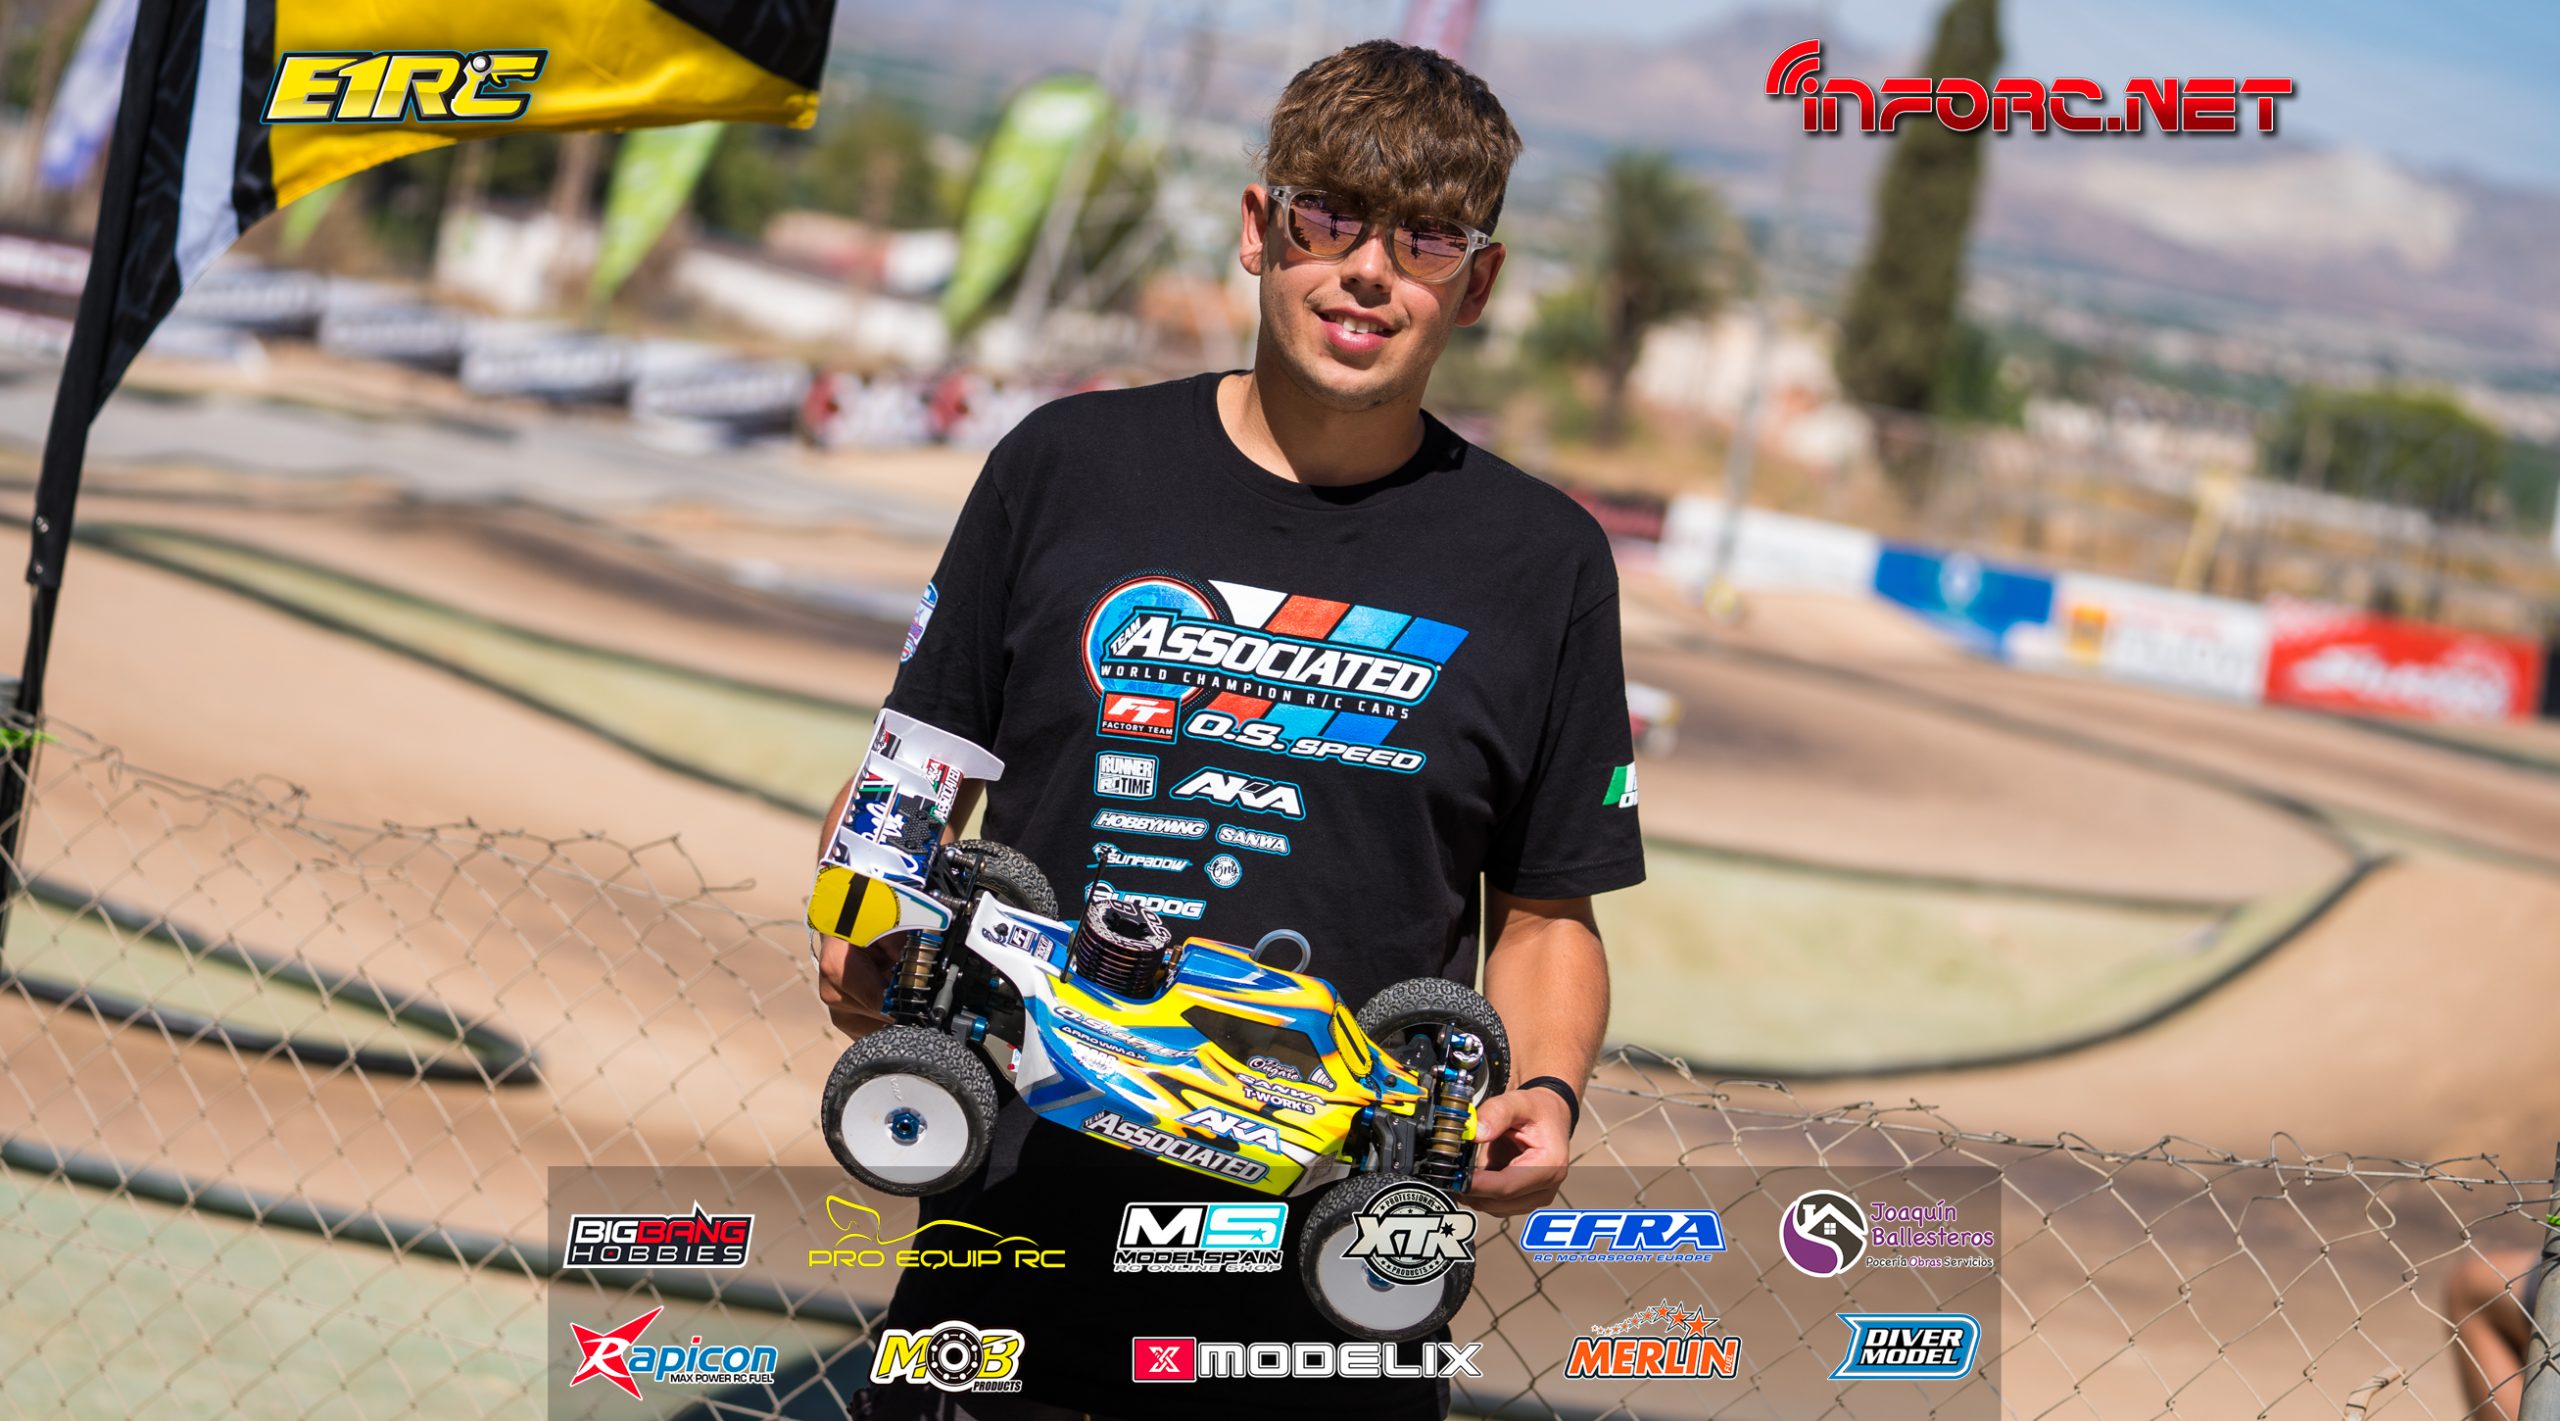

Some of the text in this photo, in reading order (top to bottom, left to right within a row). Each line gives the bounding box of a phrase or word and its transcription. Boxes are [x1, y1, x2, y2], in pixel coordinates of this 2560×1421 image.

[1109, 616, 1433, 700] TEAM ASSOCIATED
[1100, 664, 1410, 720] WORLD CHAMPION R/C CARS
[1107, 697, 1170, 723] FT
[1102, 720, 1174, 736] FACTORY TEAM
[1186, 712, 1423, 770] O.S. SPEED
[1099, 755, 1154, 778] RUNNER
[1121, 776, 1152, 795] TIME
[1174, 770, 1302, 816] AKA
[1097, 812, 1206, 837] HOBBYWING
[1219, 826, 1288, 854] SANWA
[834, 872, 871, 938] 1
[1060, 1026, 1149, 1062] ARROWMAX
[1236, 1073, 1327, 1106] SANWA
[1243, 1087, 1316, 1115] T-WORK'S
[1088, 1113, 1268, 1180] ASSOCIATED
[1178, 1107, 1281, 1153] AKA
